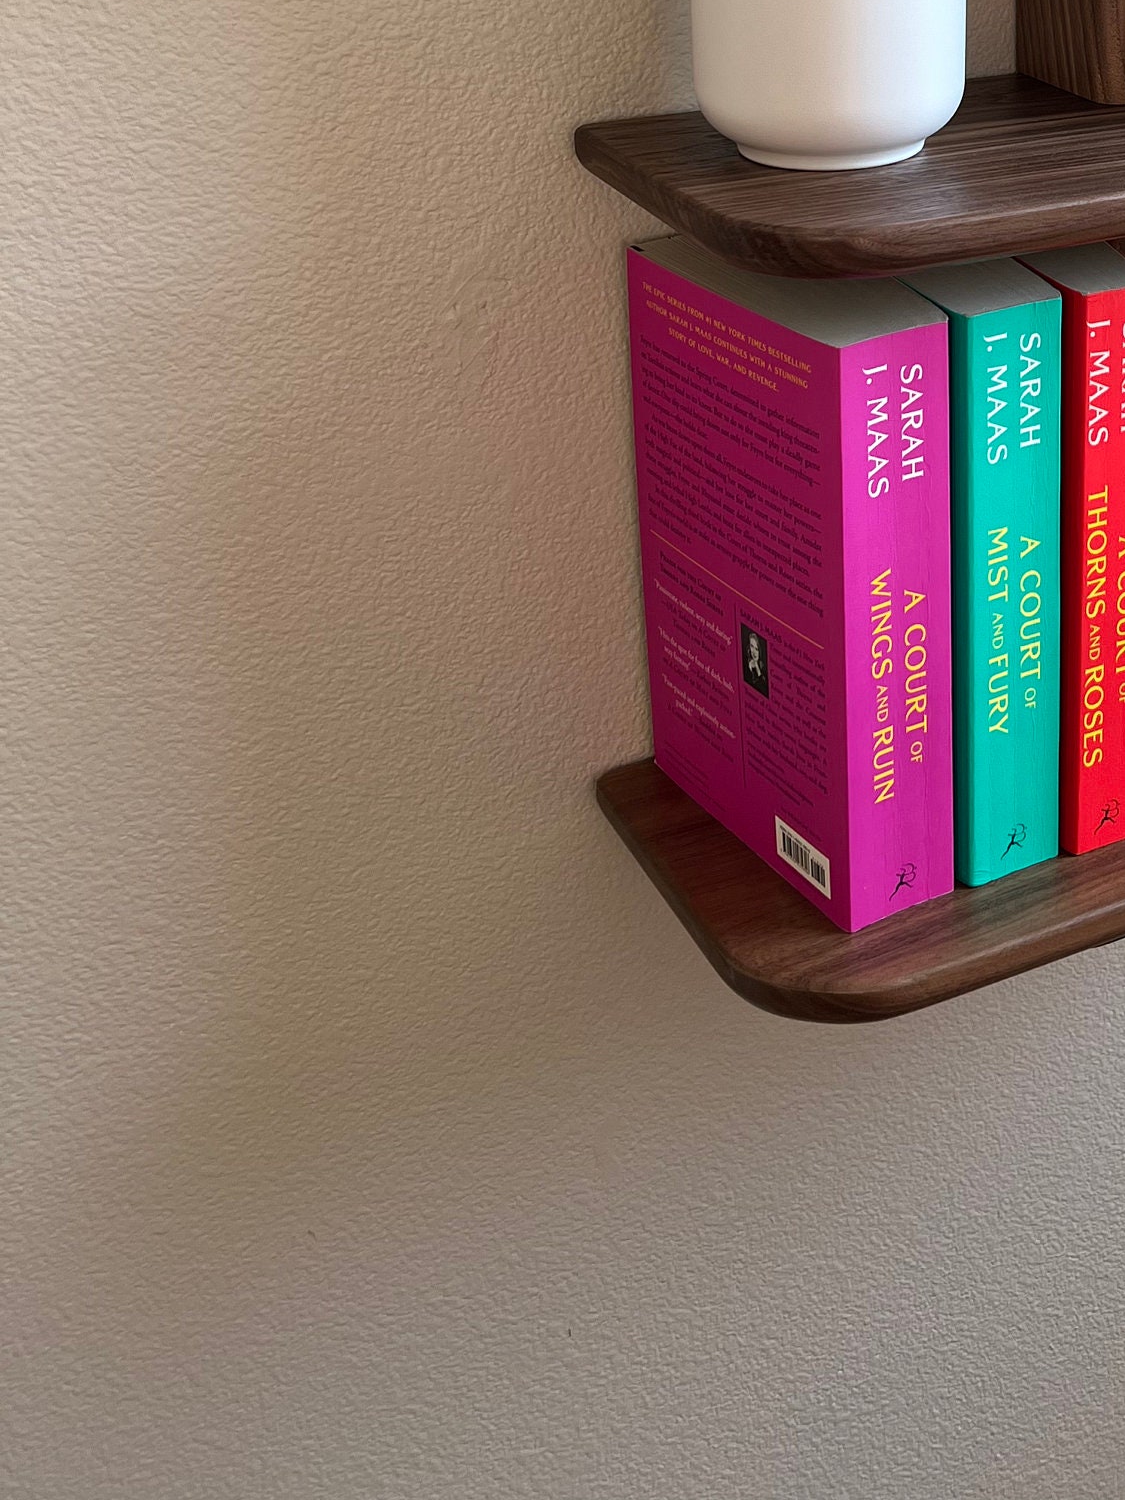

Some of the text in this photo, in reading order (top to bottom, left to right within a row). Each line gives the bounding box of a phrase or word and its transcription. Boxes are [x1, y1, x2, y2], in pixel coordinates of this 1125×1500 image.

[642, 282, 652, 292] THE
[653, 288, 666, 301] EPIC
[667, 295, 686, 312] SERIES
[687, 305, 704, 321] FROM
[713, 320, 726, 332] NEW
[728, 326, 746, 342] YORK
[748, 336, 767, 352] TIMES
[768, 346, 812, 374] BESTSELLING
[646, 300, 668, 318] AUTHOR
[668, 312, 688, 329] SARAH
[694, 326, 712, 341] MAAS
[713, 336, 748, 360] CONTINUES
[750, 354, 766, 369] WITH
[767, 365, 772, 373] A
[774, 367, 808, 389] STUNNING
[668, 327, 686, 344] STORY
[688, 339, 696, 349] OF
[733, 363, 747, 376] AND
[1020, 332, 1042, 449] SARAH
[1086, 319, 1111, 446] J. MAAS
[862, 364, 890, 499] J. MAAS
[900, 363, 924, 482] SARAH
[983, 332, 1008, 465] J. MAAS
[870, 568, 895, 805] WINGS AND RUIN
[903, 589, 927, 763] A COURT OF
[987, 526, 1009, 734] MIST AND FURY
[1019, 535, 1042, 709] A COURT OF
[1083, 484, 1109, 769] THORNS AND ROSES
